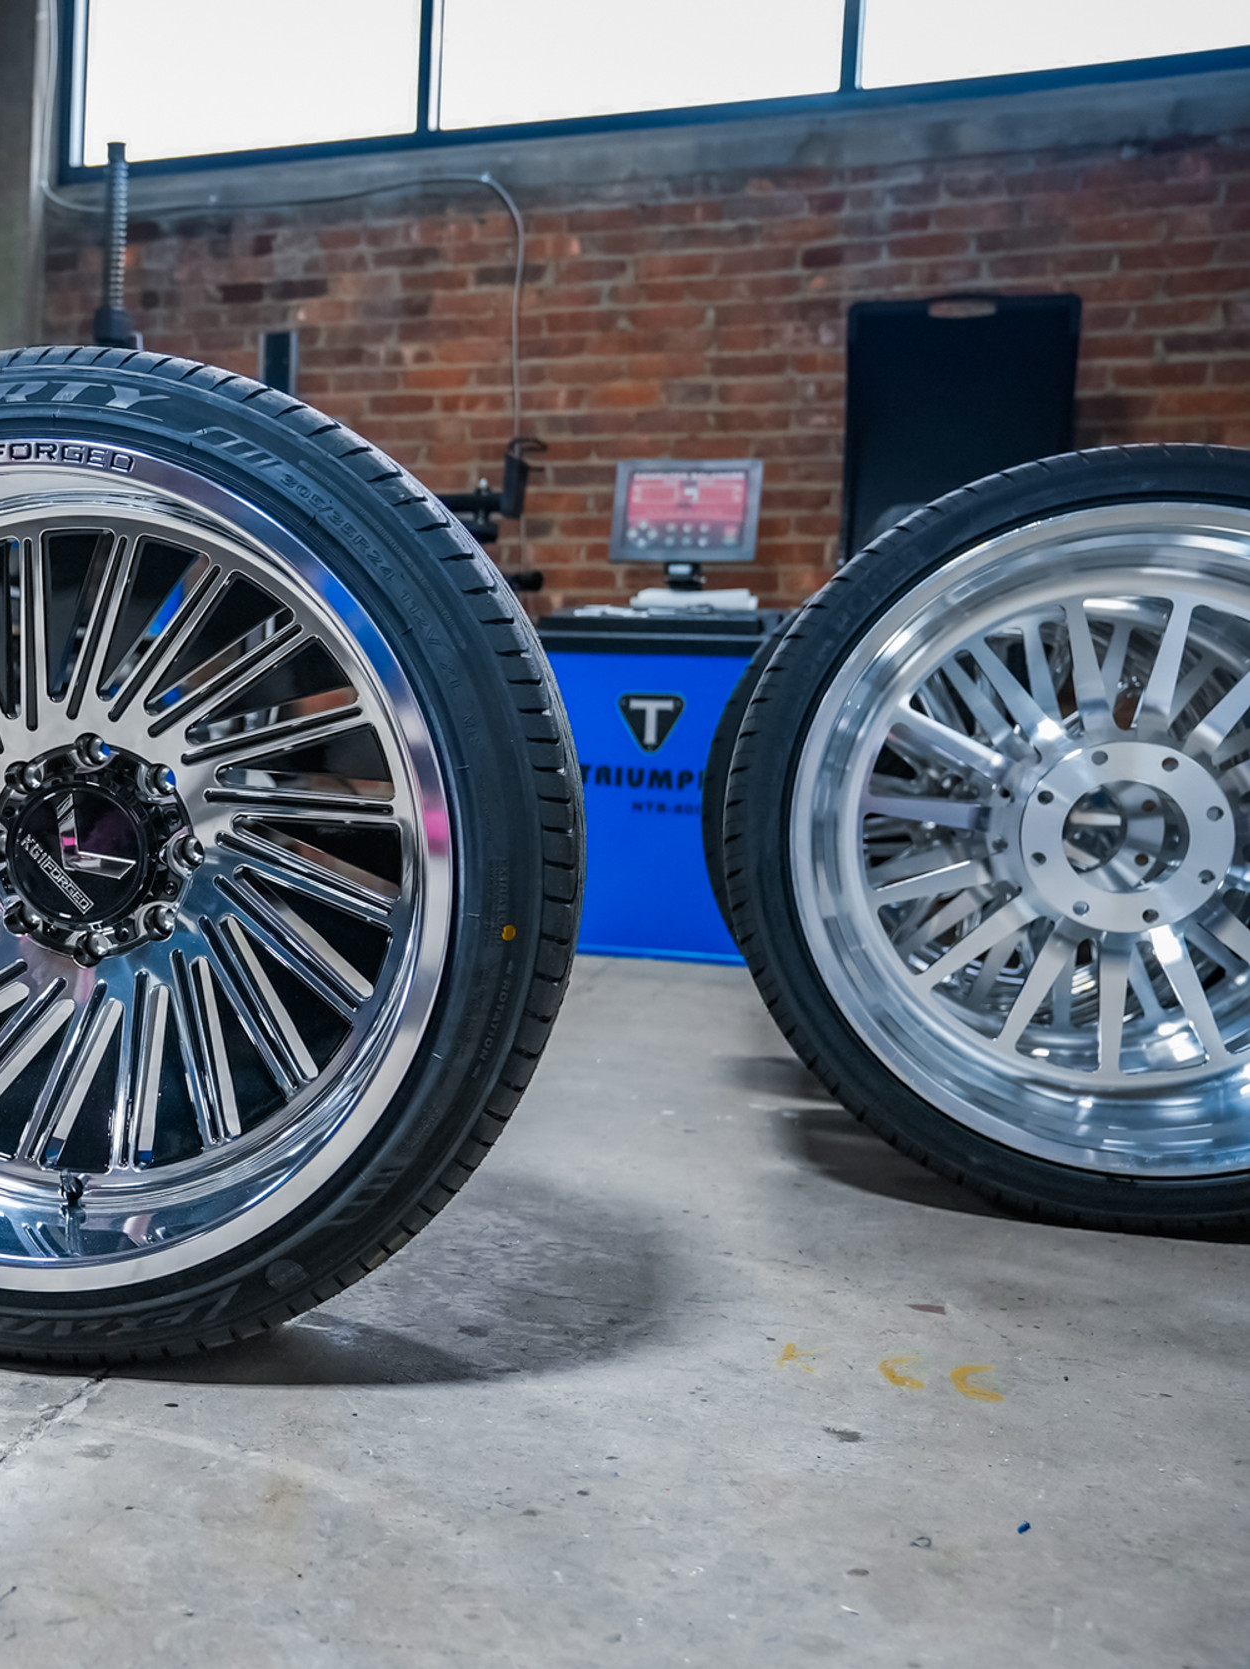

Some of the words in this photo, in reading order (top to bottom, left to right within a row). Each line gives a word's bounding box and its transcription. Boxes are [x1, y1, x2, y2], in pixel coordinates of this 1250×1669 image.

[278, 472, 397, 584] 305/35R24
[20, 833, 48, 865] KG1
[43, 860, 91, 910] FORGED
[479, 979, 512, 1063] ROTATION
